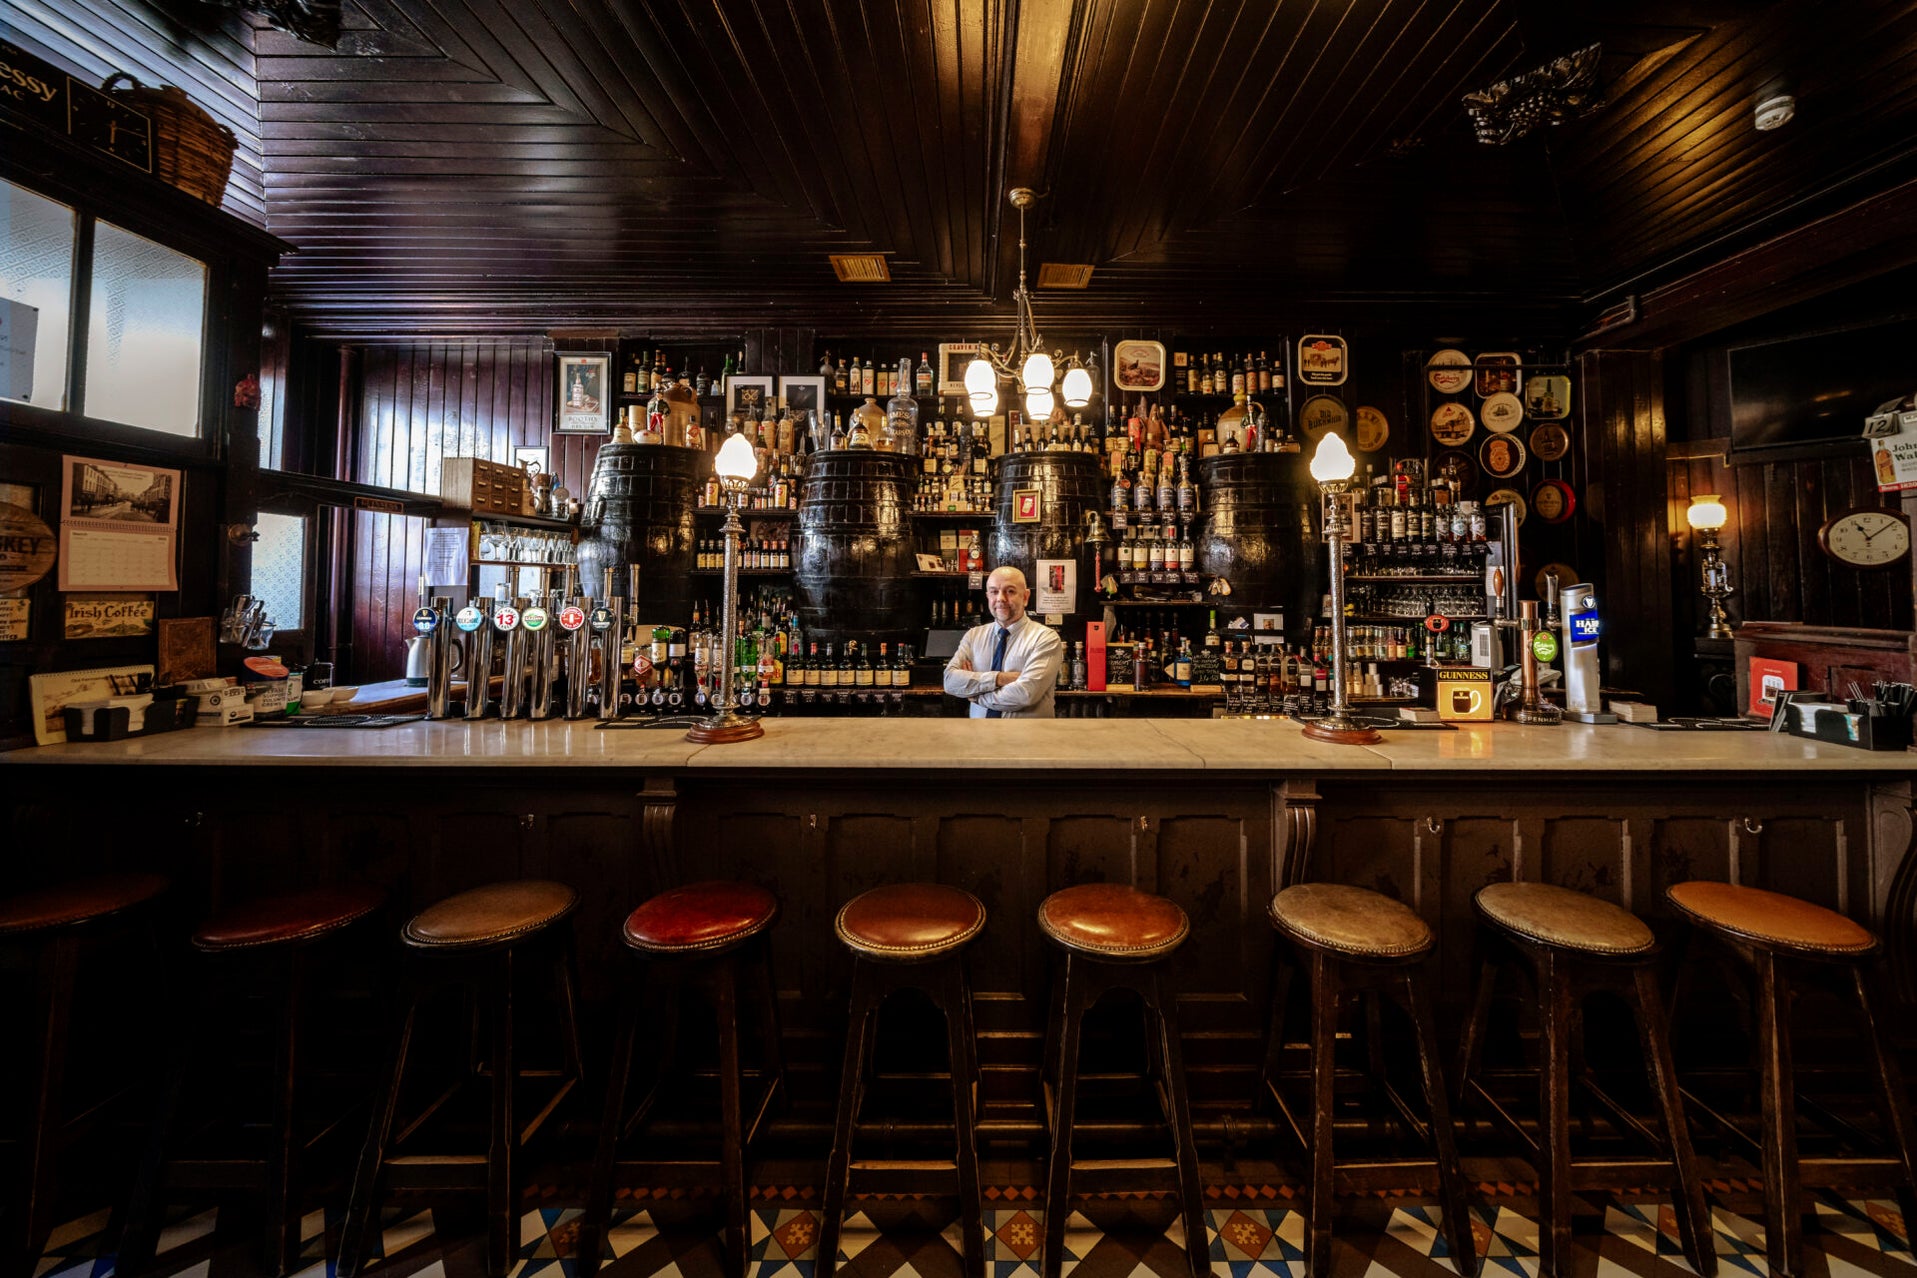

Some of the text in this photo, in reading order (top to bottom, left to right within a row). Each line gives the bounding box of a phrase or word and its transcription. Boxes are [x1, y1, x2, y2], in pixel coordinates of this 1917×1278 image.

[70, 605, 148, 620] Irish Coffee
[496, 613, 514, 626] 13
[1438, 671, 1489, 680] GUINNESS
